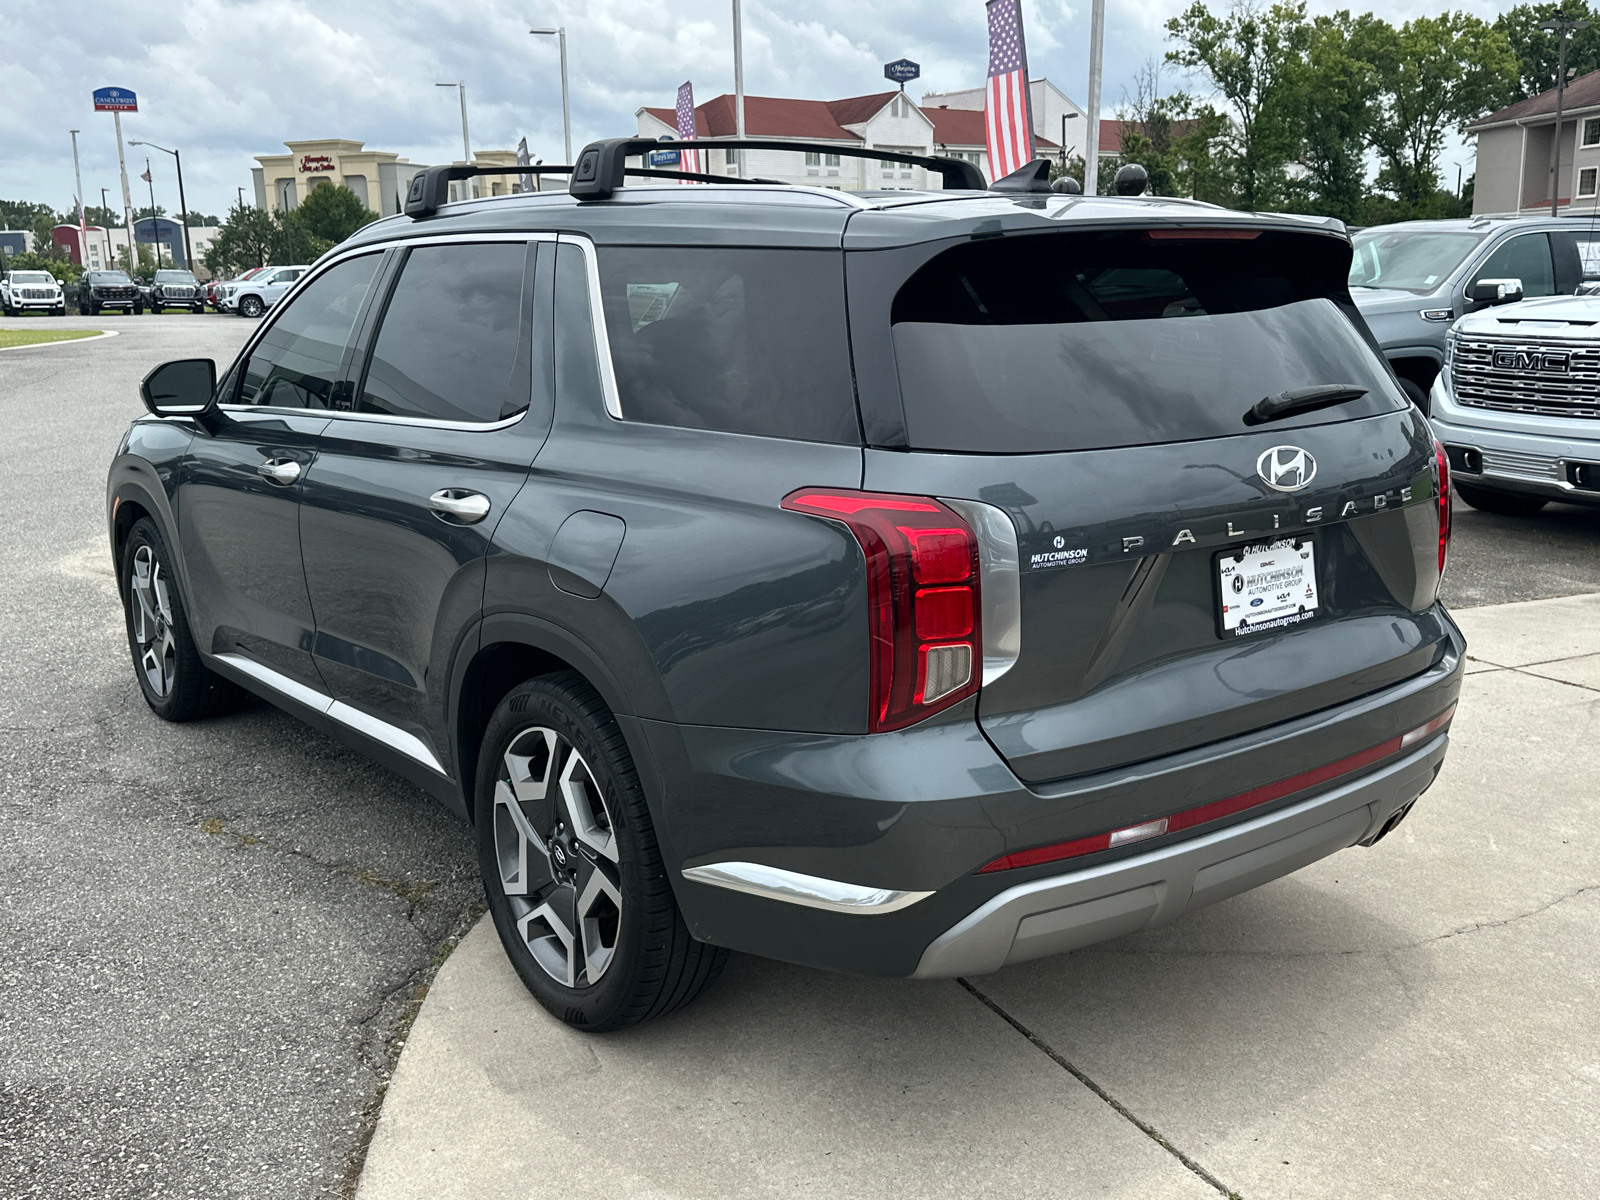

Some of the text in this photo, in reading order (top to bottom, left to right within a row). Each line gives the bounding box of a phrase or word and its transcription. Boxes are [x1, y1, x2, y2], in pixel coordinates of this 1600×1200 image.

[300, 155, 332, 164] Hampton
[653, 154, 667, 162] Days
[667, 152, 677, 160] Inn
[1495, 351, 1567, 371] GMC
[1122, 486, 1412, 553] PALISADE
[1251, 537, 1297, 555] HUTCHINSON
[1031, 548, 1088, 563] HUTCHINSON
[1032, 560, 1068, 569] AUTOMOTIVE
[1260, 560, 1275, 568] GMC
[1246, 565, 1304, 588] HUTCHINSON
[1248, 578, 1303, 596] AUTOMOTIVE GROUP
[1235, 611, 1314, 636] Hutchinsonautogroup.com
[541, 699, 598, 765] NEXEN
